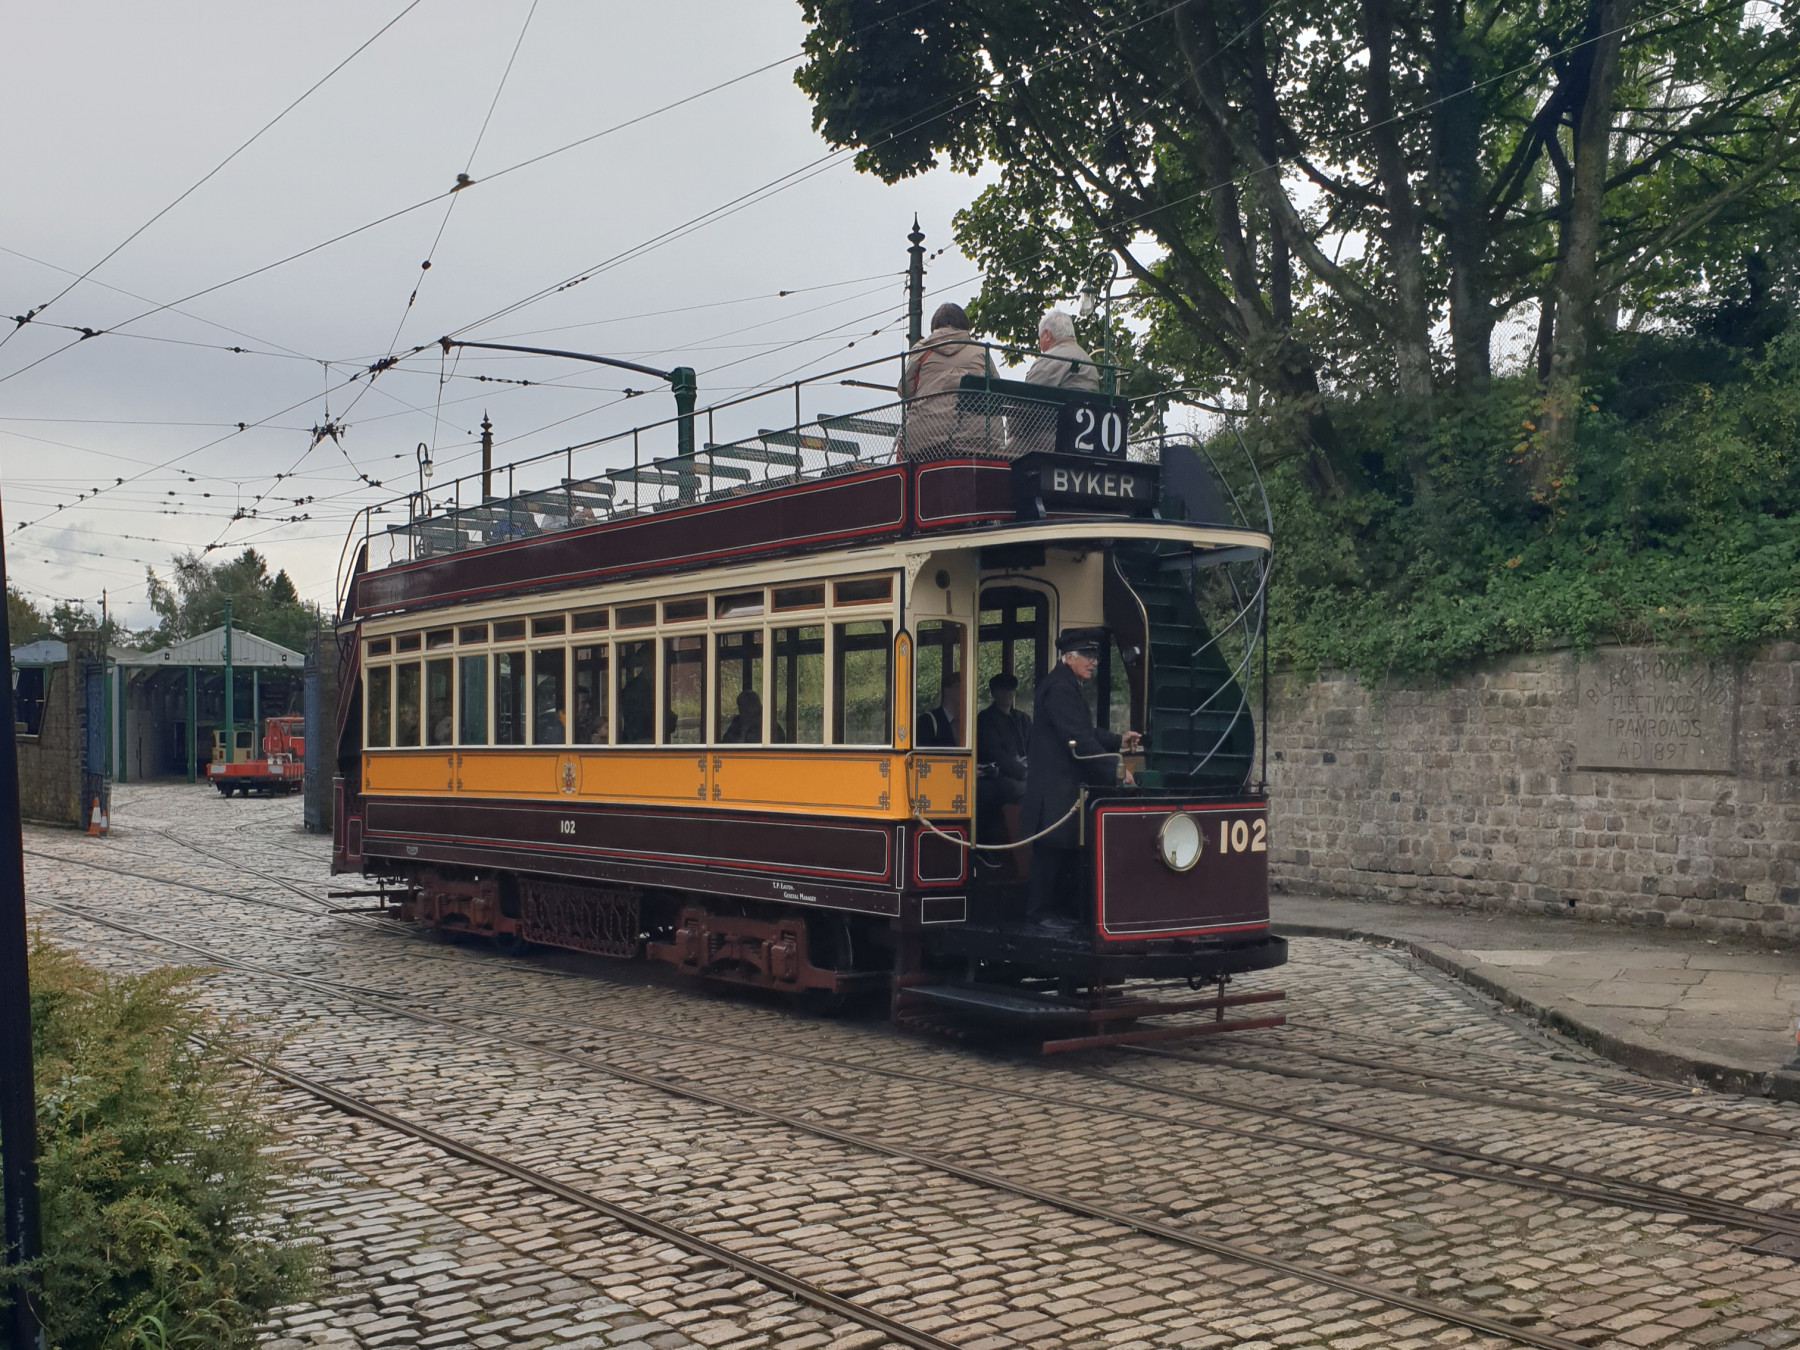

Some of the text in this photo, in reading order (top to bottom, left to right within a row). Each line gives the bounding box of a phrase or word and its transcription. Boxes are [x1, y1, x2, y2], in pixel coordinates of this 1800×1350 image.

[1075, 408, 1122, 453] 20
[1053, 469, 1134, 498] BYKER
[1586, 661, 1729, 705] BLACKPOOL AND
[1611, 695, 1696, 714] FLEETWOOD
[1607, 719, 1702, 738] TRAMROADS
[1617, 743, 1689, 761] AD 1897
[560, 820, 576, 834] 102
[1220, 818, 1267, 854] 102
